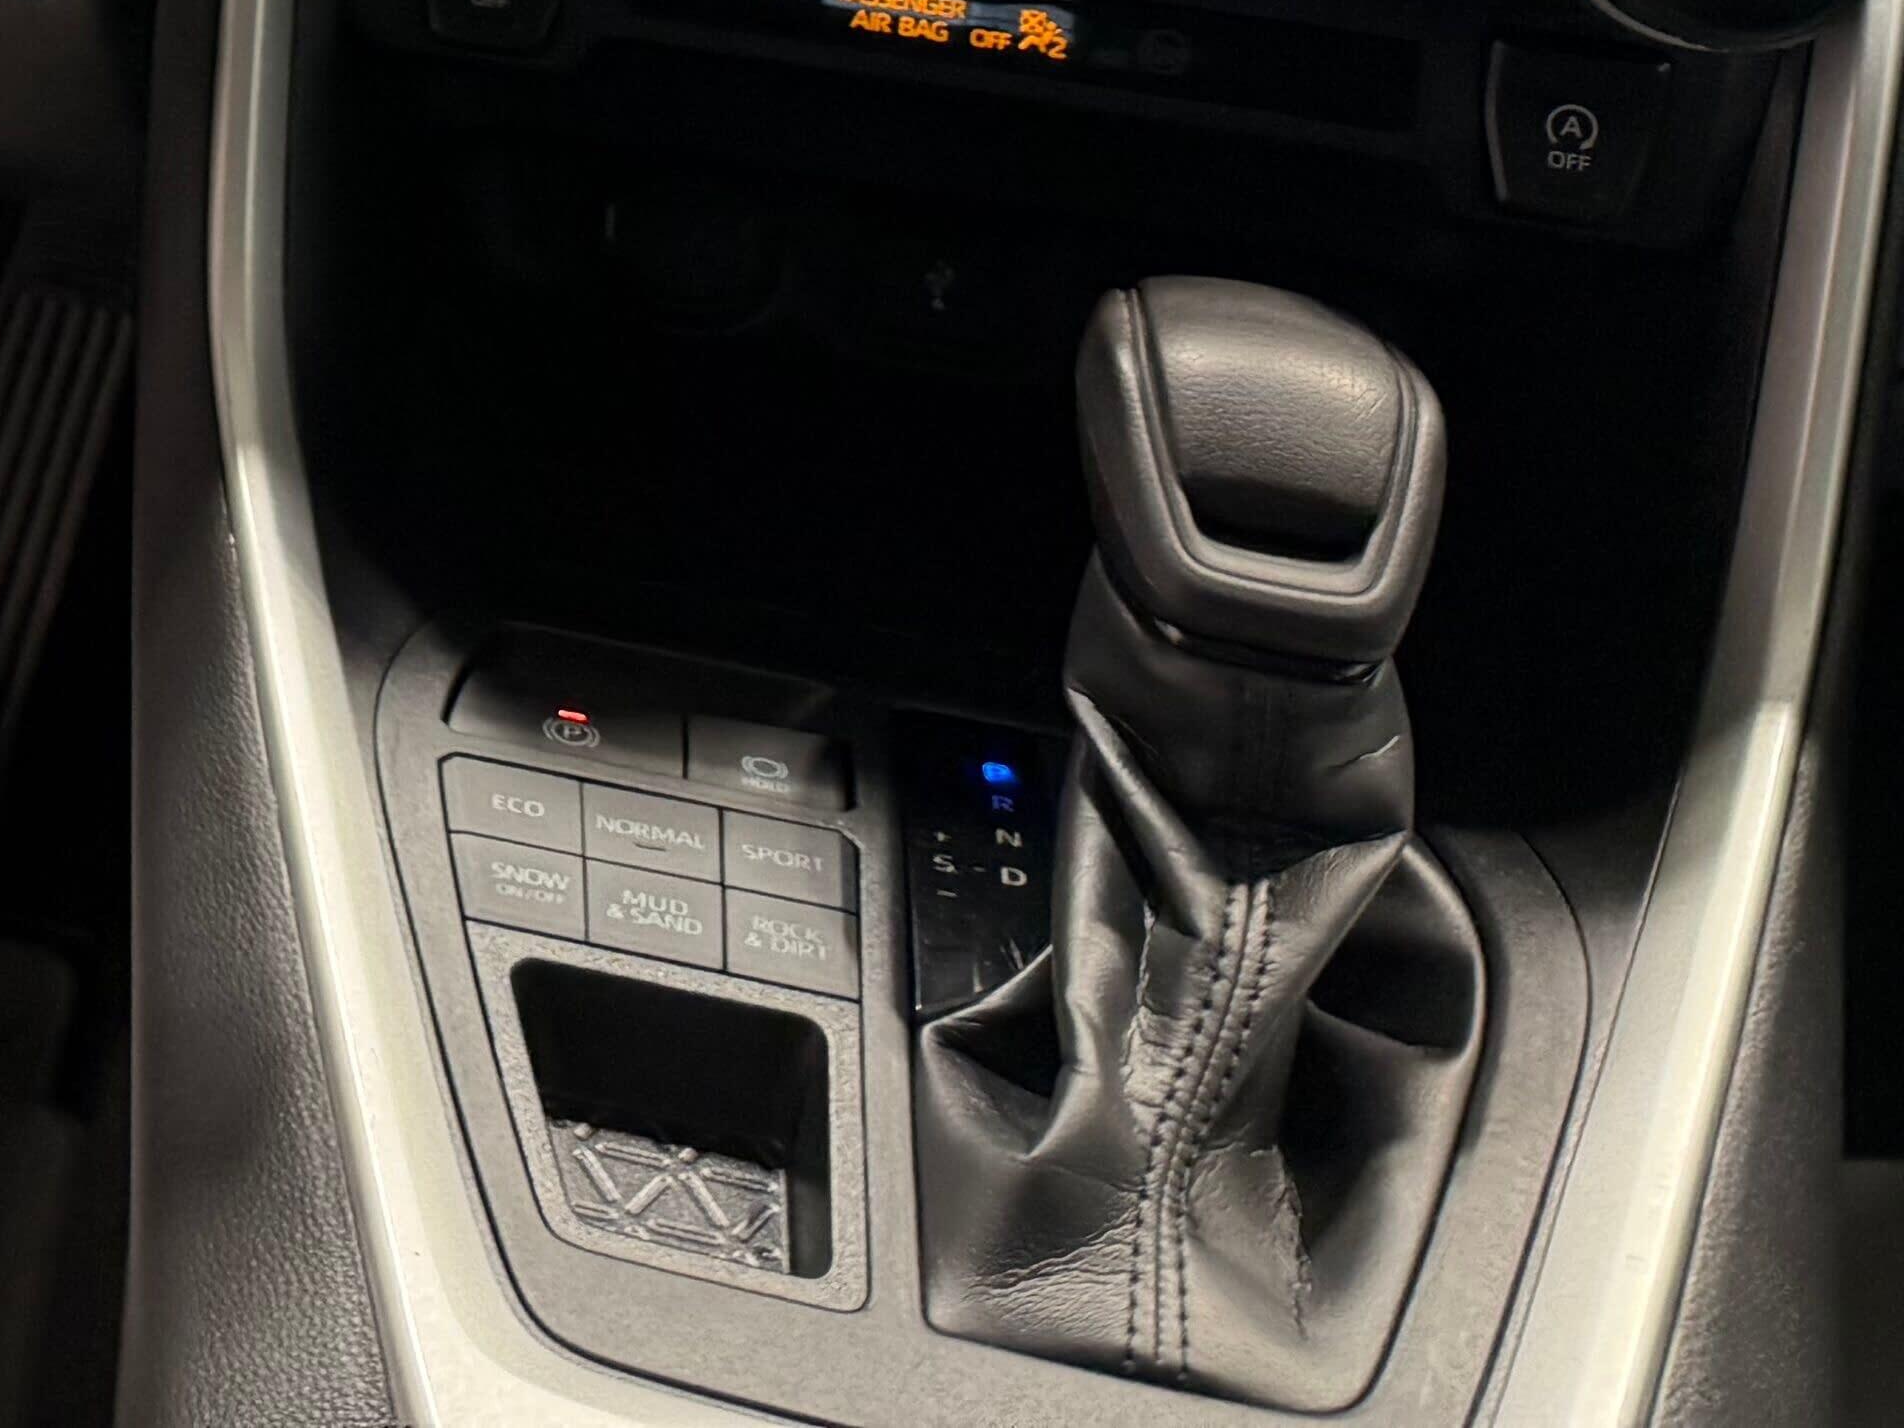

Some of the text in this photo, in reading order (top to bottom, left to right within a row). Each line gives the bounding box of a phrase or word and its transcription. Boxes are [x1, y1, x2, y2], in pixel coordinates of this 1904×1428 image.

[850, 9, 1013, 50] AIR BAG OFF
[1547, 150, 1592, 172] OFF
[492, 794, 545, 818] ECO
[595, 815, 705, 851] NORMAL
[995, 827, 1023, 848] N
[742, 844, 824, 873] SPORT
[491, 861, 570, 891] SNOW
[1000, 866, 1028, 886] D
[622, 889, 689, 917] MUD
[606, 903, 703, 936] & SAND
[752, 915, 826, 944] ROCK
[770, 938, 828, 961] DIRT
